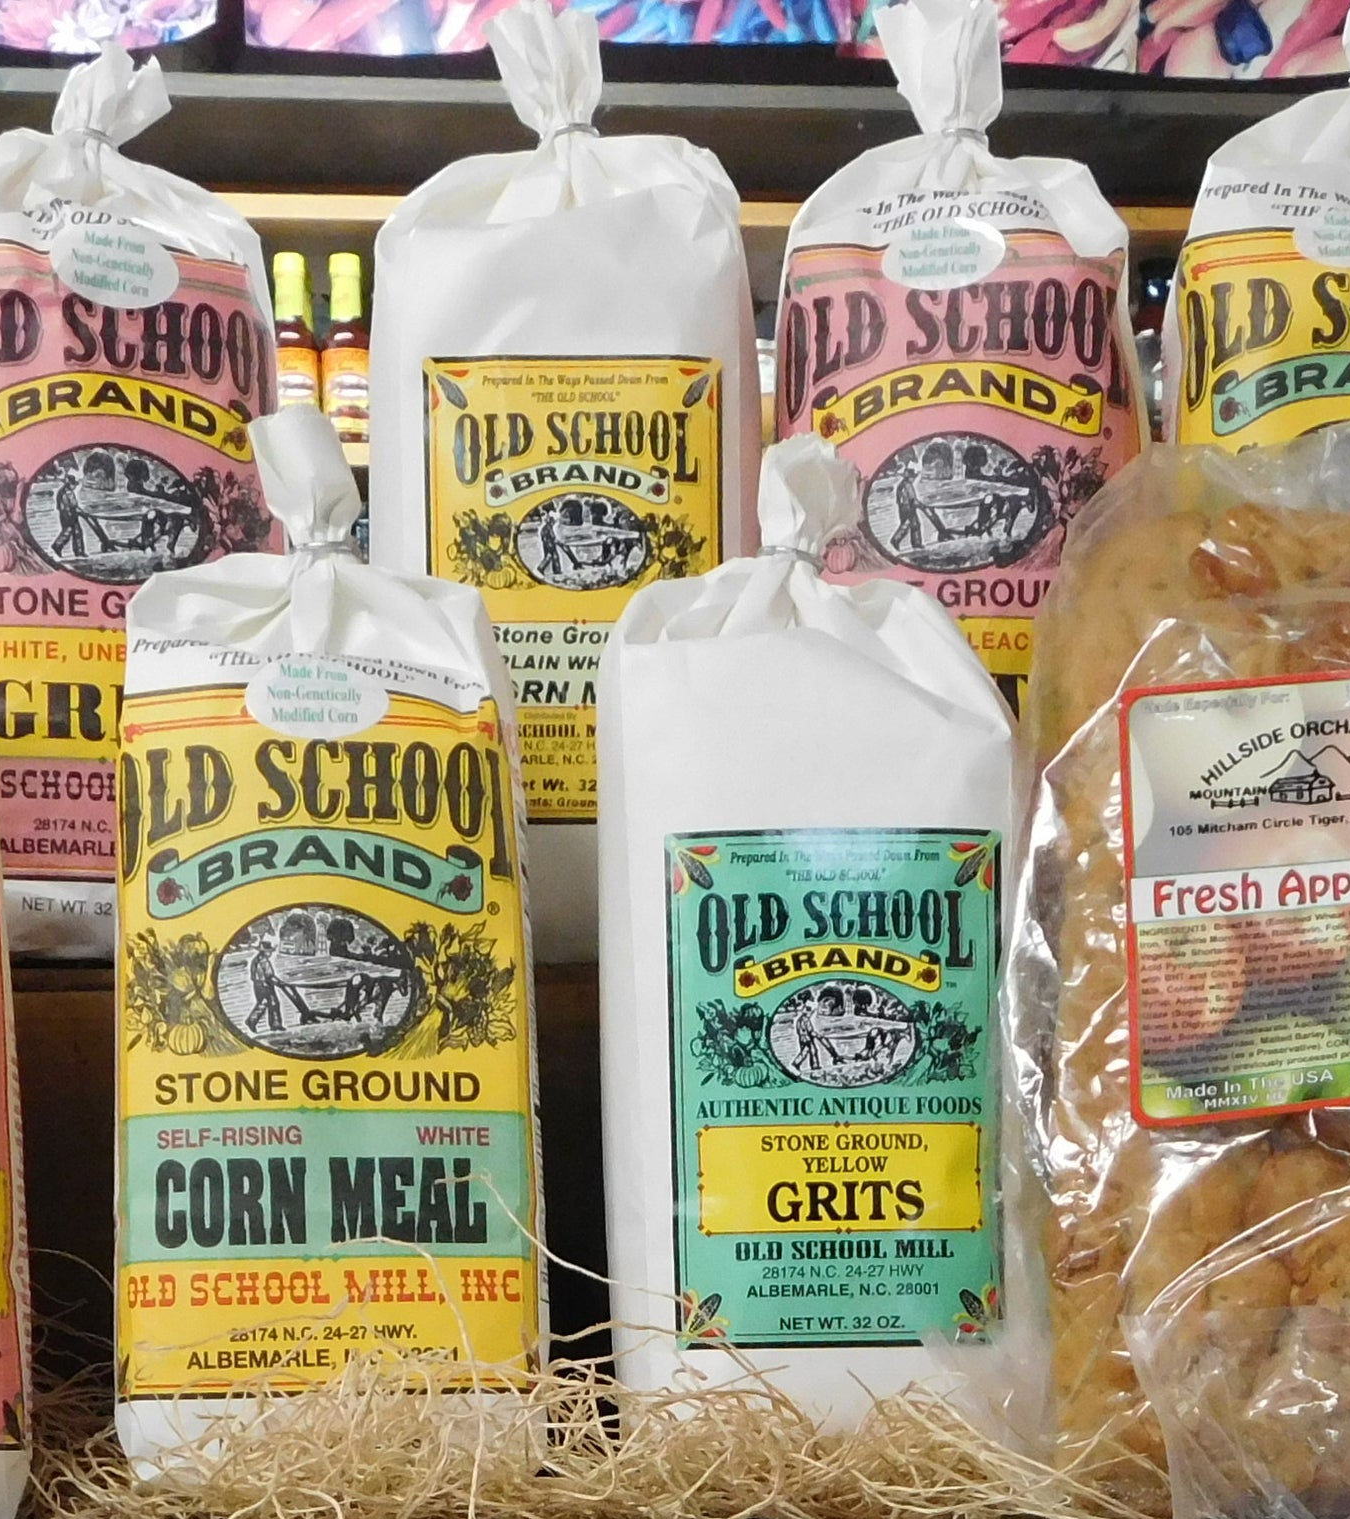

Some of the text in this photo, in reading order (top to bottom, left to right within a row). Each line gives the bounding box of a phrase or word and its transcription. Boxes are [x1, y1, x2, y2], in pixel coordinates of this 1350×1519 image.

[785, 292, 887, 425] OLD
[1185, 275, 1294, 412] OLD
[8, 380, 218, 437] BRAND
[853, 370, 1058, 428] BRAND
[452, 409, 700, 486] OLD SCHOOL
[512, 465, 643, 493] BRAND
[279, 663, 348, 684] Made From
[266, 686, 362, 705] Non-Genetically
[271, 706, 358, 724] Modified Corn
[1201, 727, 1285, 786] HILLSIDE
[1189, 785, 1268, 800] MOUNTAIN
[122, 745, 235, 884] OLD
[198, 835, 432, 896] BRAND
[1153, 874, 1263, 917] Fresh
[696, 889, 976, 975] OLD SCHOOL
[764, 950, 913, 982] BRAND
[154, 1070, 481, 1105] STONE GROUND
[1165, 1069, 1335, 1100] Made In USA
[696, 1095, 983, 1119] AUTHENTIC ANTIQUE FOODS
[157, 1125, 490, 1149] SELF-RISING WHITE
[760, 1133, 928, 1153] STONE GROUND,
[803, 1156, 889, 1174] YELLOW
[154, 1157, 488, 1249] CORN MEAL
[767, 1180, 926, 1225] GRITS
[734, 1238, 954, 1262] OLD SCHOOL MILL
[762, 1264, 925, 1280] 28174 N.C. 24-27 HWY
[127, 1274, 177, 1309] OLD
[190, 1270, 330, 1307] SCHOOL
[343, 1269, 446, 1306] MILL,
[779, 1314, 906, 1332] NET WT. 32 OZ.
